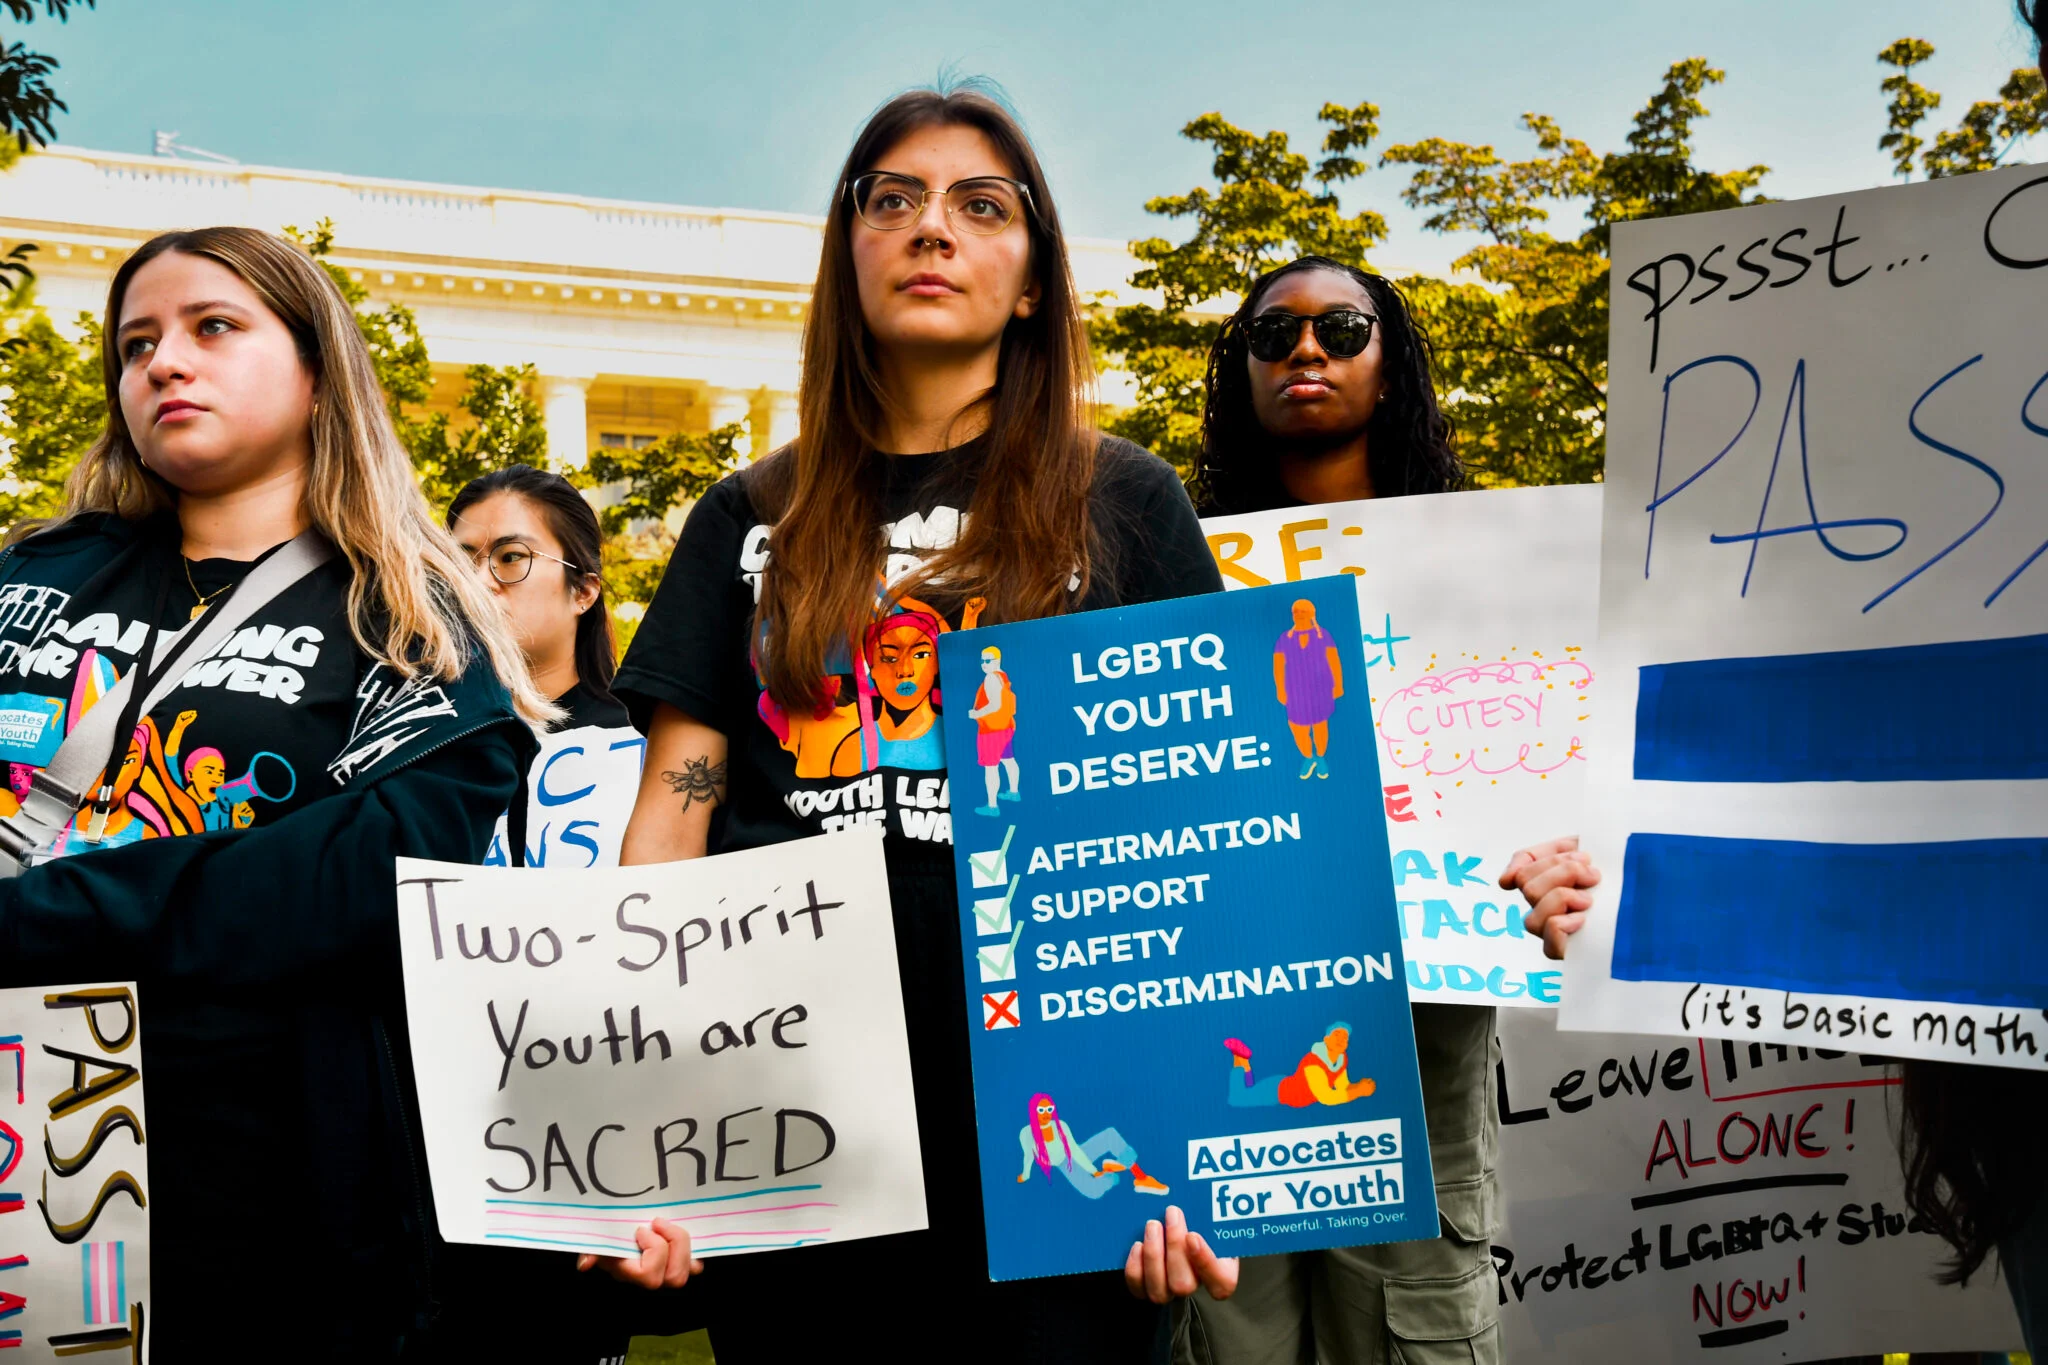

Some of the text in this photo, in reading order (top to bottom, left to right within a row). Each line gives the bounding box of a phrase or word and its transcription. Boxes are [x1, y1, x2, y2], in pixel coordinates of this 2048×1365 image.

[1073, 633, 1227, 684] LGBTQ
[0, 714, 43, 726] ocates
[1074, 685, 1233, 736] YOUTH
[1406, 693, 1543, 735] CUTESY
[1049, 735, 1272, 795] DESERVE:
[899, 809, 954, 845] WA
[1027, 813, 1301, 875] AFFIRMATION
[1031, 874, 1210, 923] SUPPORT
[1036, 927, 1183, 972] SAFETY
[1041, 952, 1393, 1021] DISCRIMINATION
[1404, 960, 1563, 1003] UDGE
[1681, 984, 1763, 1031] (it's
[1782, 991, 1893, 1039] basic
[487, 998, 808, 1091] Youth are
[1496, 1036, 1693, 1125] Leave
[37, 986, 147, 1245] PASS
[1645, 1099, 1855, 1181] ALONE!
[484, 1106, 836, 1198] SACRED
[1192, 1131, 1398, 1175] Advocates
[1216, 1169, 1401, 1217] for Youth
[1214, 1211, 1408, 1240] Young. Powerful. Taking Over.
[1490, 1228, 1652, 1306] Protect
